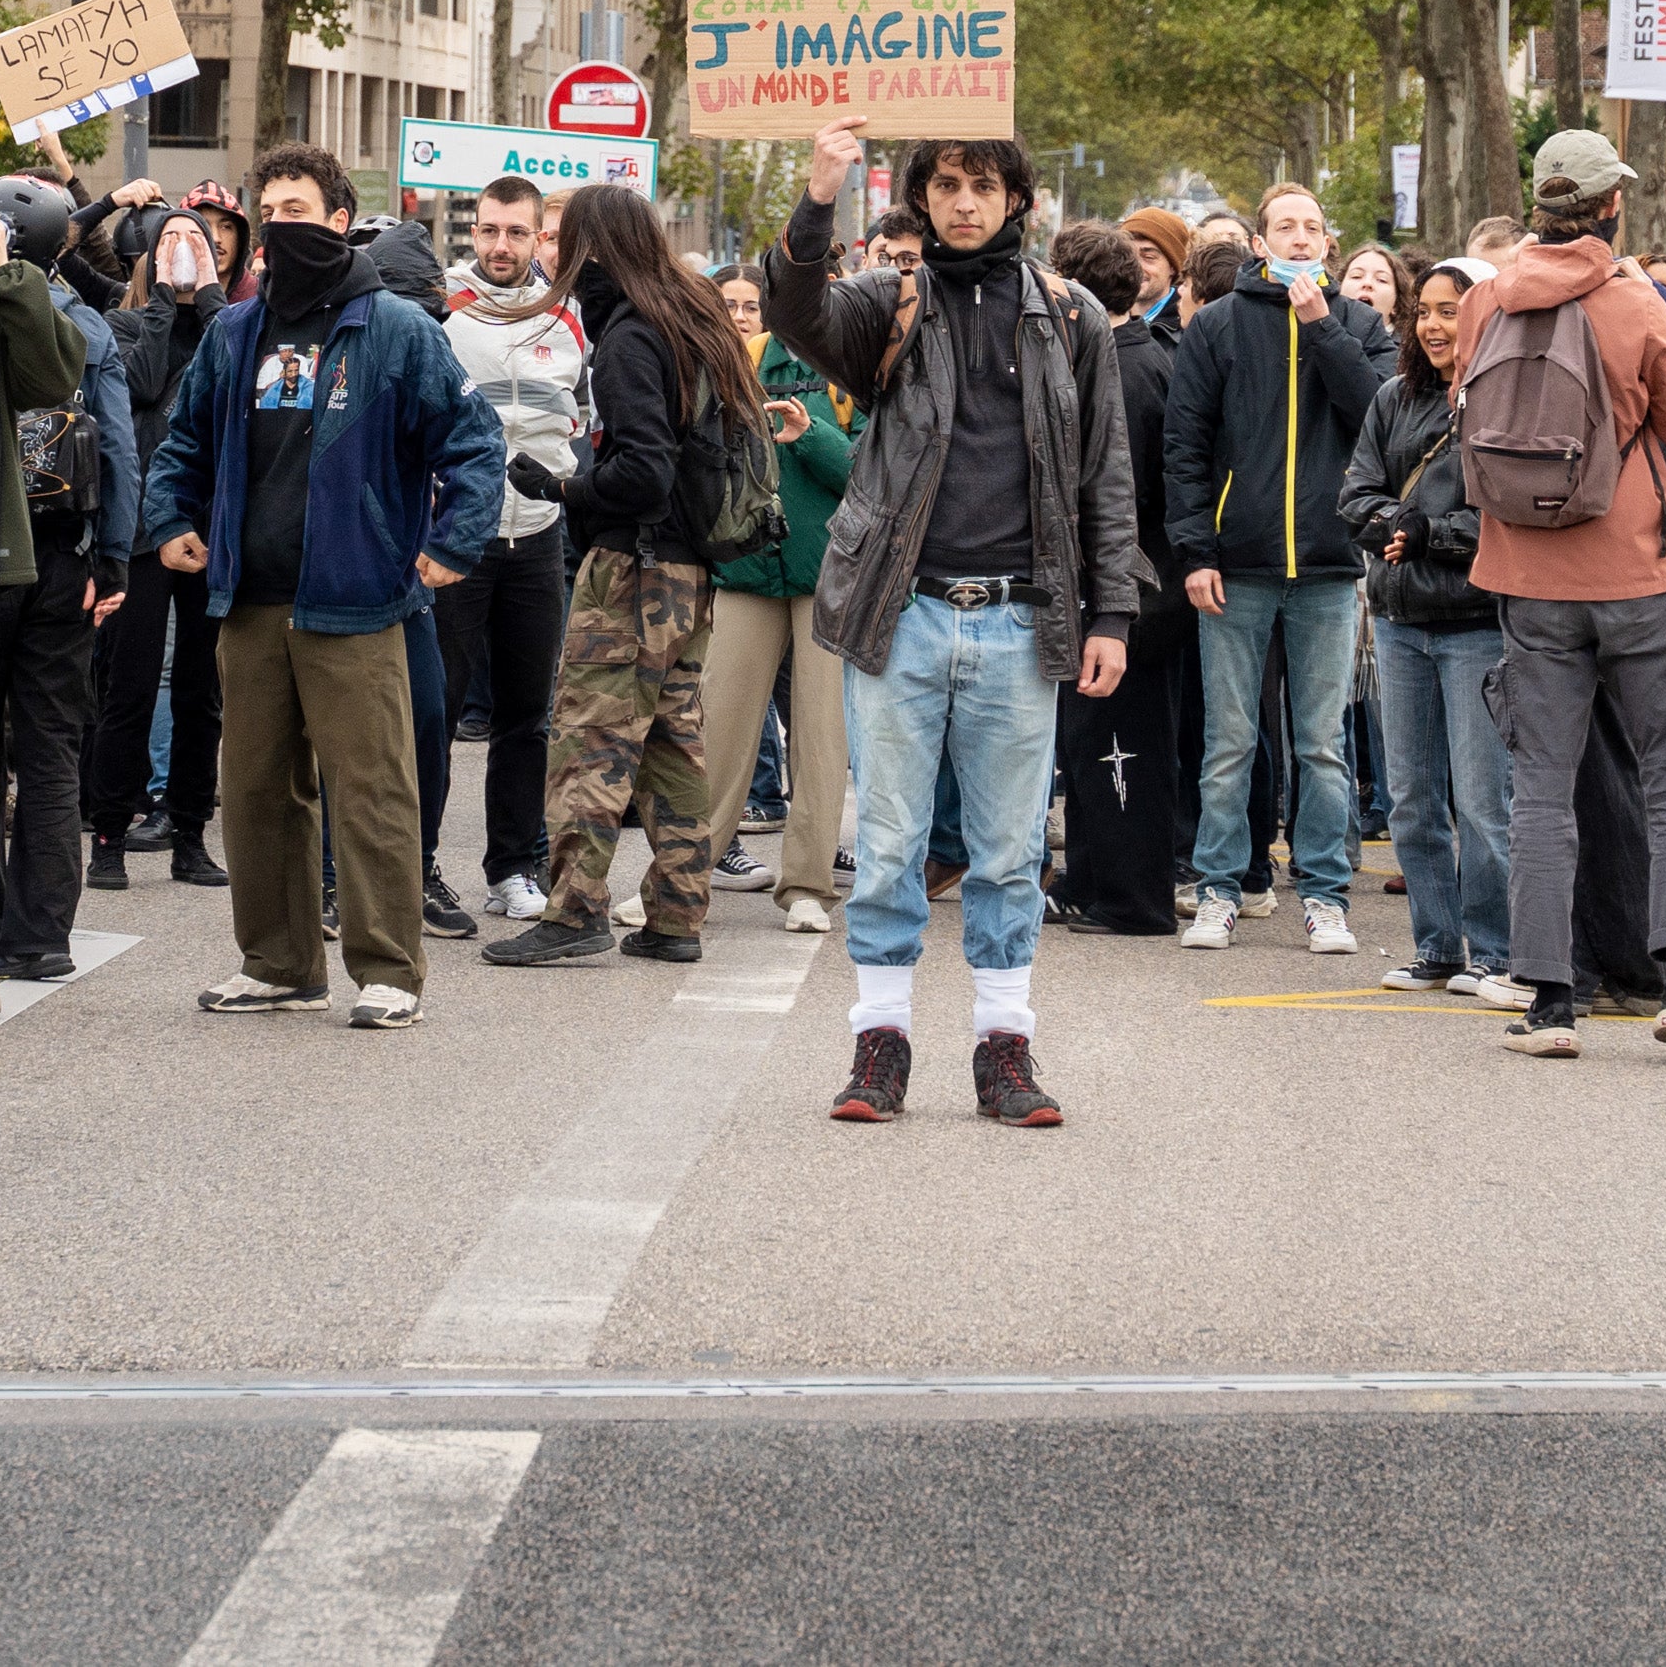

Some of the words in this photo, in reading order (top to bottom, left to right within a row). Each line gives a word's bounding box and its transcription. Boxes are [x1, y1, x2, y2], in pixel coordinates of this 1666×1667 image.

[691, 10, 1007, 70] J'IMAGINE
[35, 50, 82, 101] SÉ
[89, 38, 139, 79] YO
[696, 74, 746, 113] UN
[752, 70, 850, 107] MONDE
[868, 61, 1011, 102] PARFAIT
[502, 150, 589, 179] Accès
[327, 401, 348, 410] Tour
[328, 391, 349, 401] ATP
